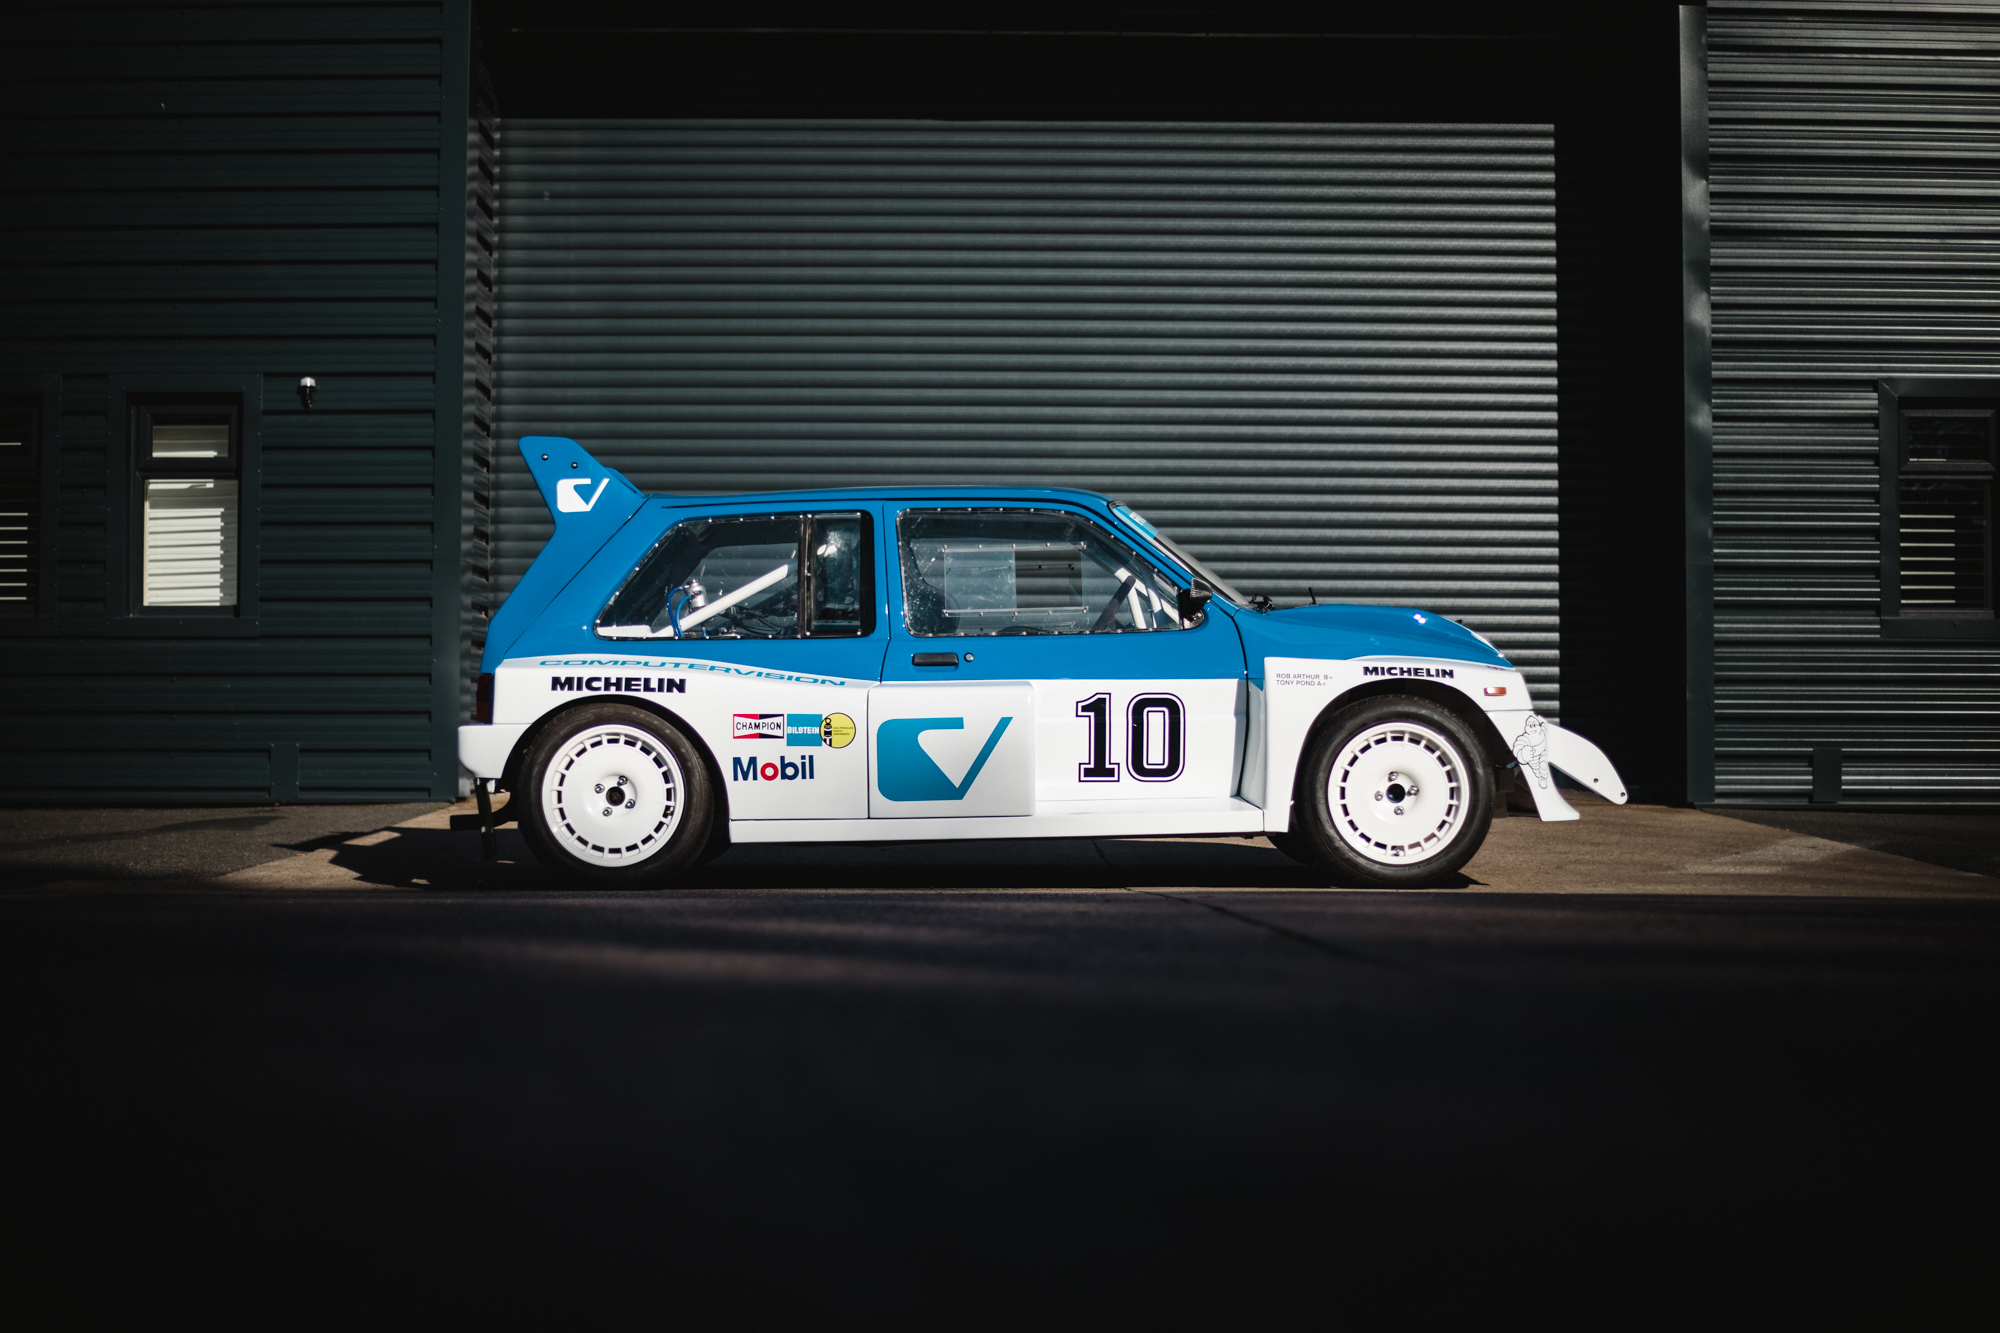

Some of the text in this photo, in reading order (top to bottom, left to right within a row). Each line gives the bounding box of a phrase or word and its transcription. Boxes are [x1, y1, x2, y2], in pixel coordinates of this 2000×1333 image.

[539, 659, 846, 686] COMPUTERVISION
[1363, 666, 1455, 679] MICHELIN
[551, 676, 686, 693] MICHELIN
[735, 721, 782, 731] CHAMPION
[787, 726, 820, 734] BILSTEIN
[1076, 692, 1186, 782] 10
[732, 754, 815, 782] Mobil
